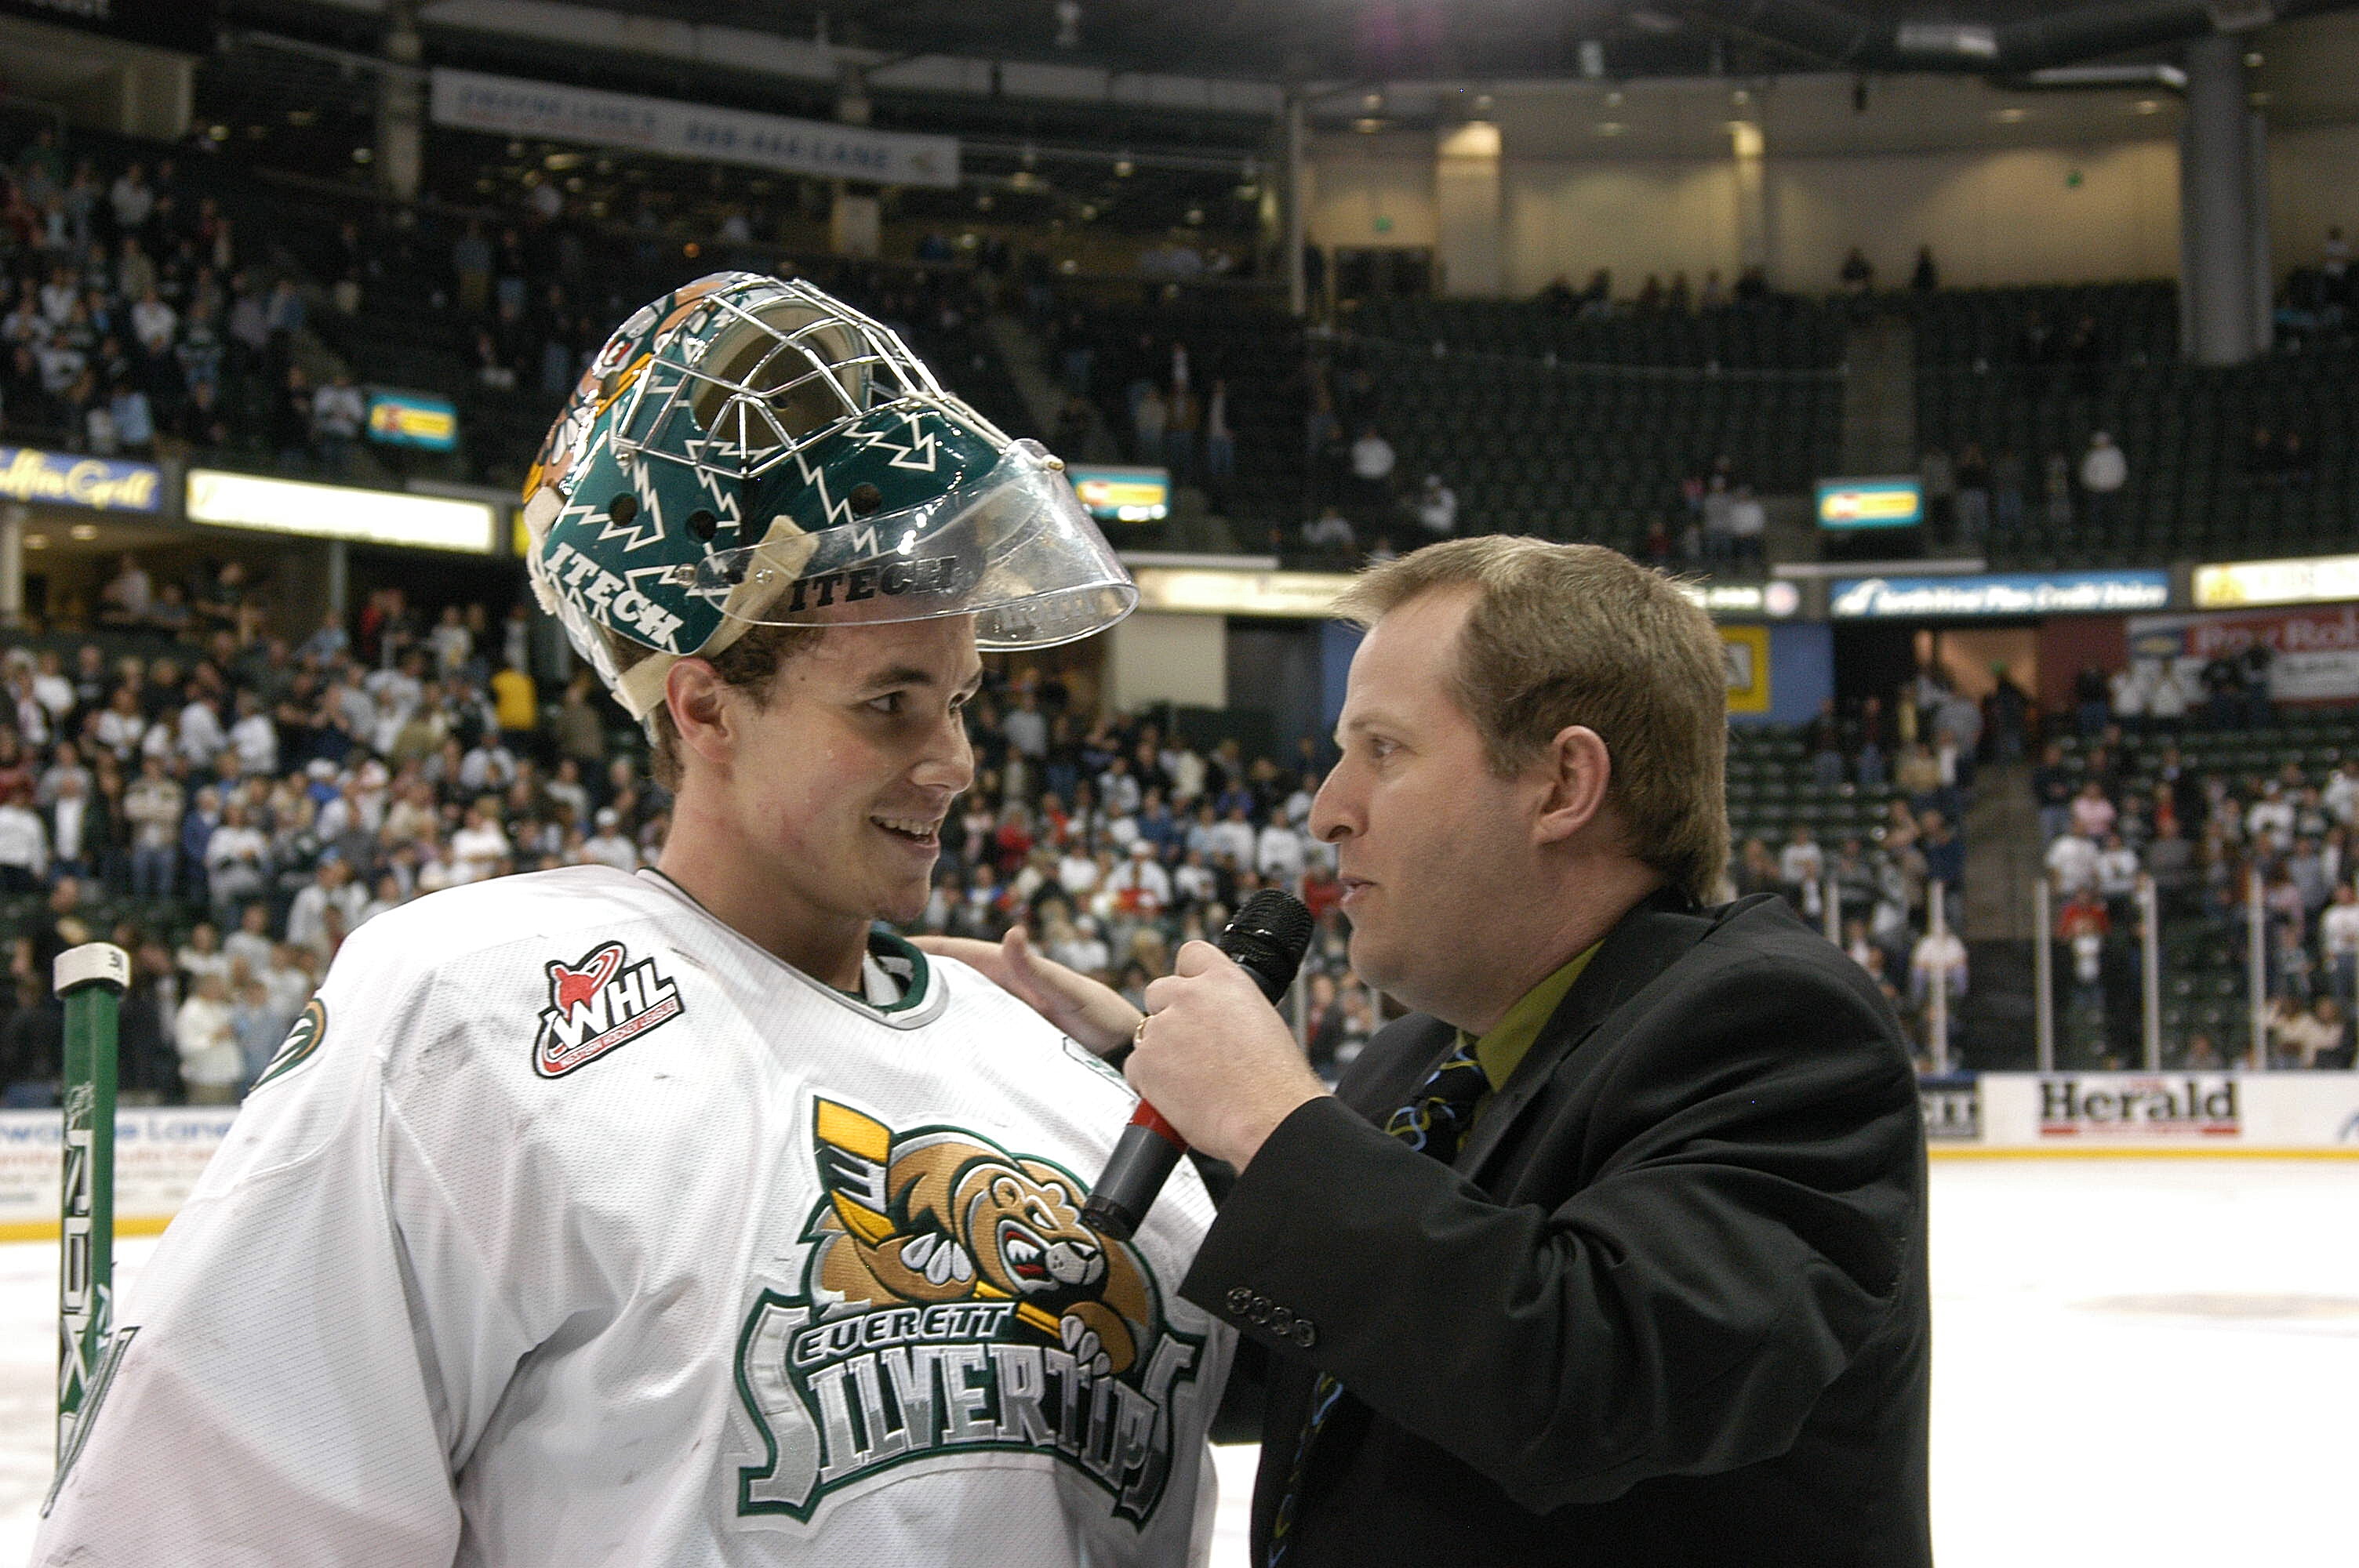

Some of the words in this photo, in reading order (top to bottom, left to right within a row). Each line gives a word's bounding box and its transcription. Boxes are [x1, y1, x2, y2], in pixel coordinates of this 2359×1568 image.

[544, 543, 685, 646] ITECH
[788, 555, 959, 612] ITECH
[542, 961, 677, 1050] WHL
[2041, 1080, 2240, 1122] Herald
[793, 1301, 1017, 1367] EVERETT
[739, 1298, 1200, 1525] SILVERTIPS
